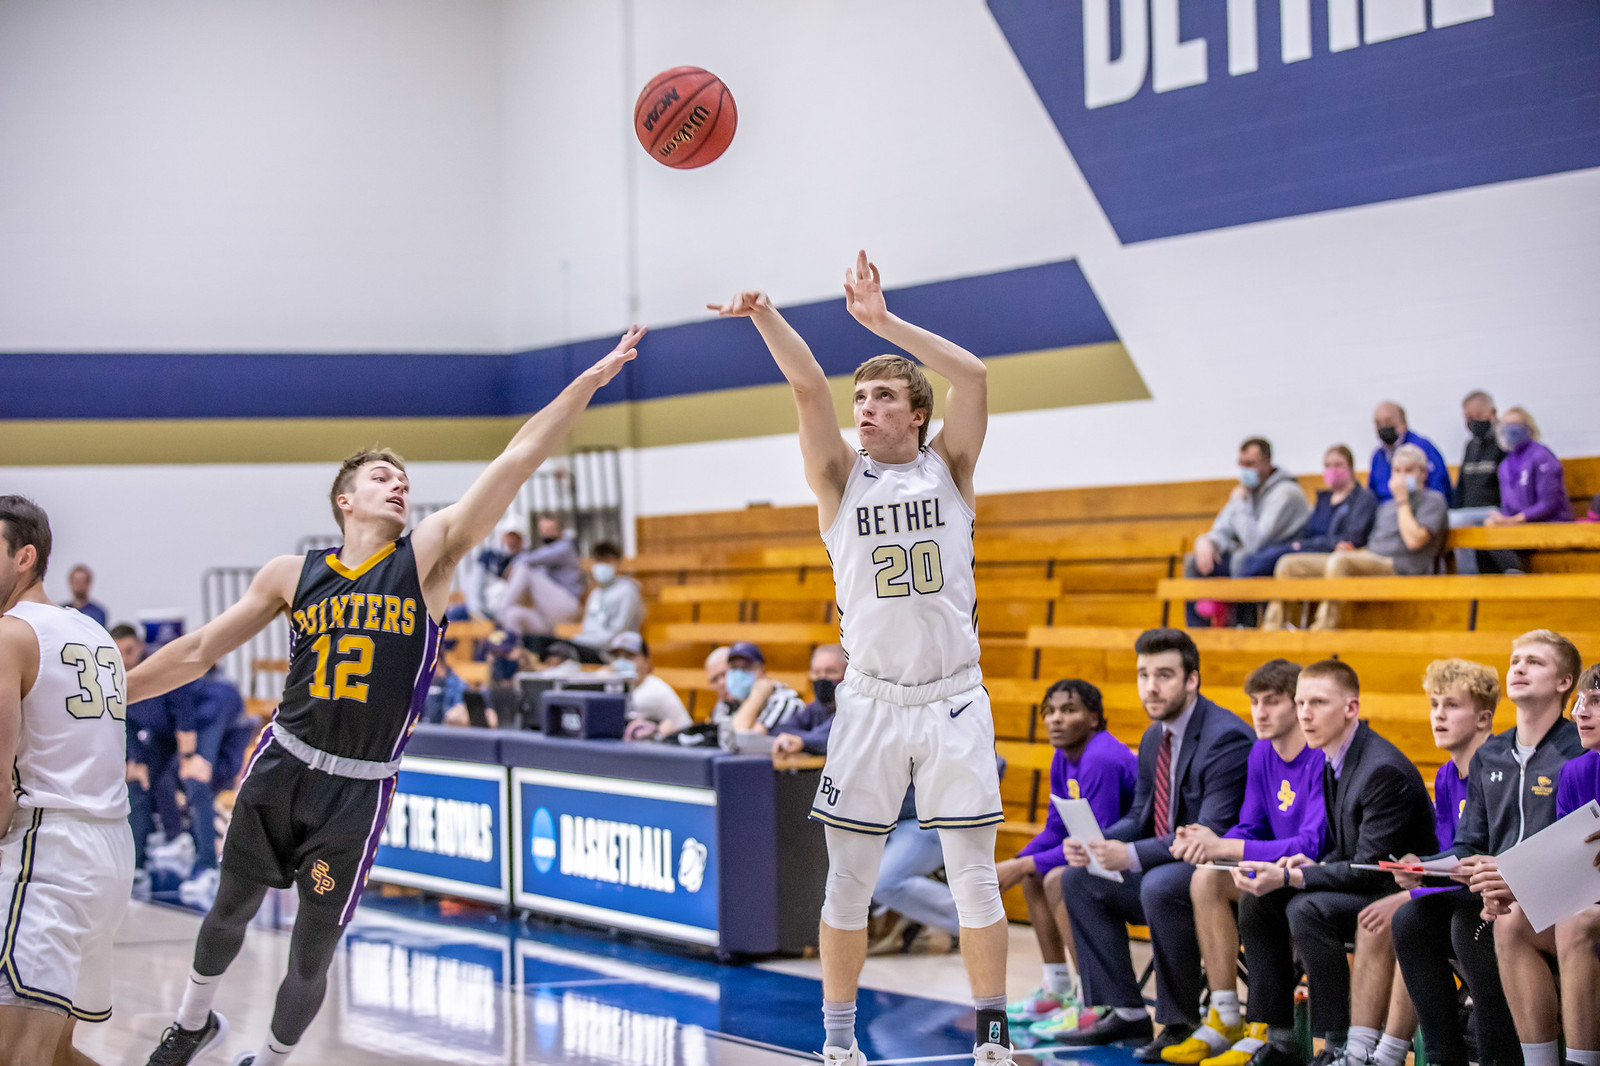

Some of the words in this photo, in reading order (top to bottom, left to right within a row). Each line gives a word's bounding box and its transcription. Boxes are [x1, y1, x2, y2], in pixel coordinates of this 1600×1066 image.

[643, 87, 680, 132] NCAA
[658, 104, 712, 157] Wilson
[856, 497, 946, 537] BETHEL
[871, 539, 945, 599] 20
[293, 592, 416, 640] POINTERS
[60, 642, 127, 722] 33
[308, 633, 376, 704] 12
[559, 813, 676, 894] BASKETBALL
